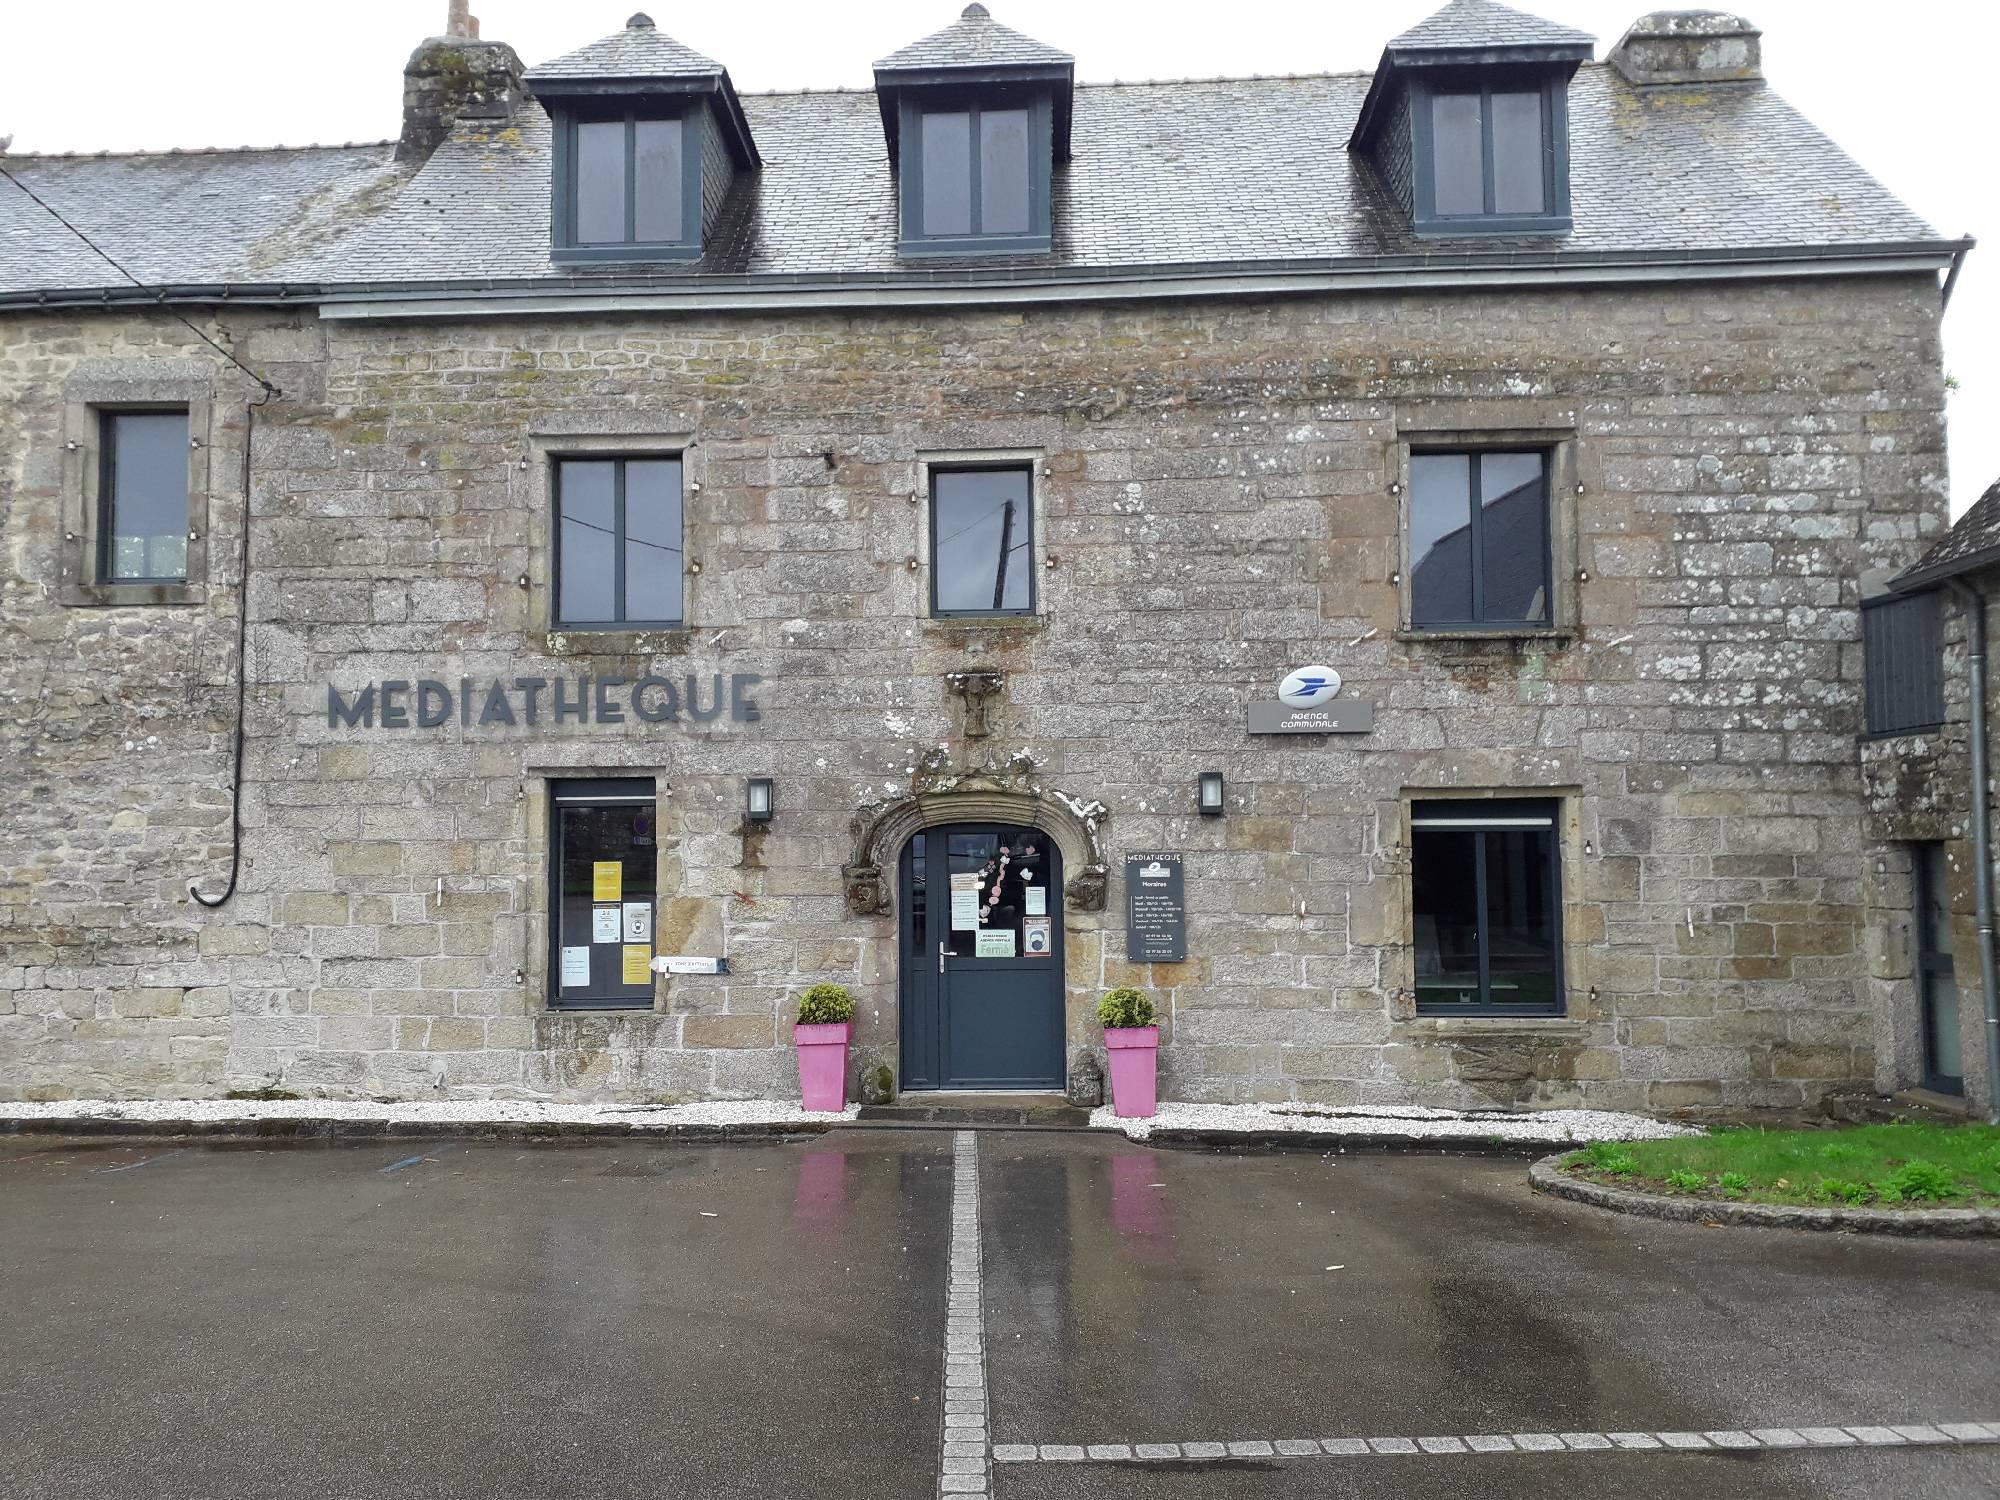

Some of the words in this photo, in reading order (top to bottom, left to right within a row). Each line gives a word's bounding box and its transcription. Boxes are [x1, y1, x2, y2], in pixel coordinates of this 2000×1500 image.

[328, 673, 762, 729] MEDIATHEQUE
[1291, 712, 1329, 720] AGENCE
[1280, 720, 1339, 728] COMMUNALE
[980, 944, 1009, 954] Fermé
